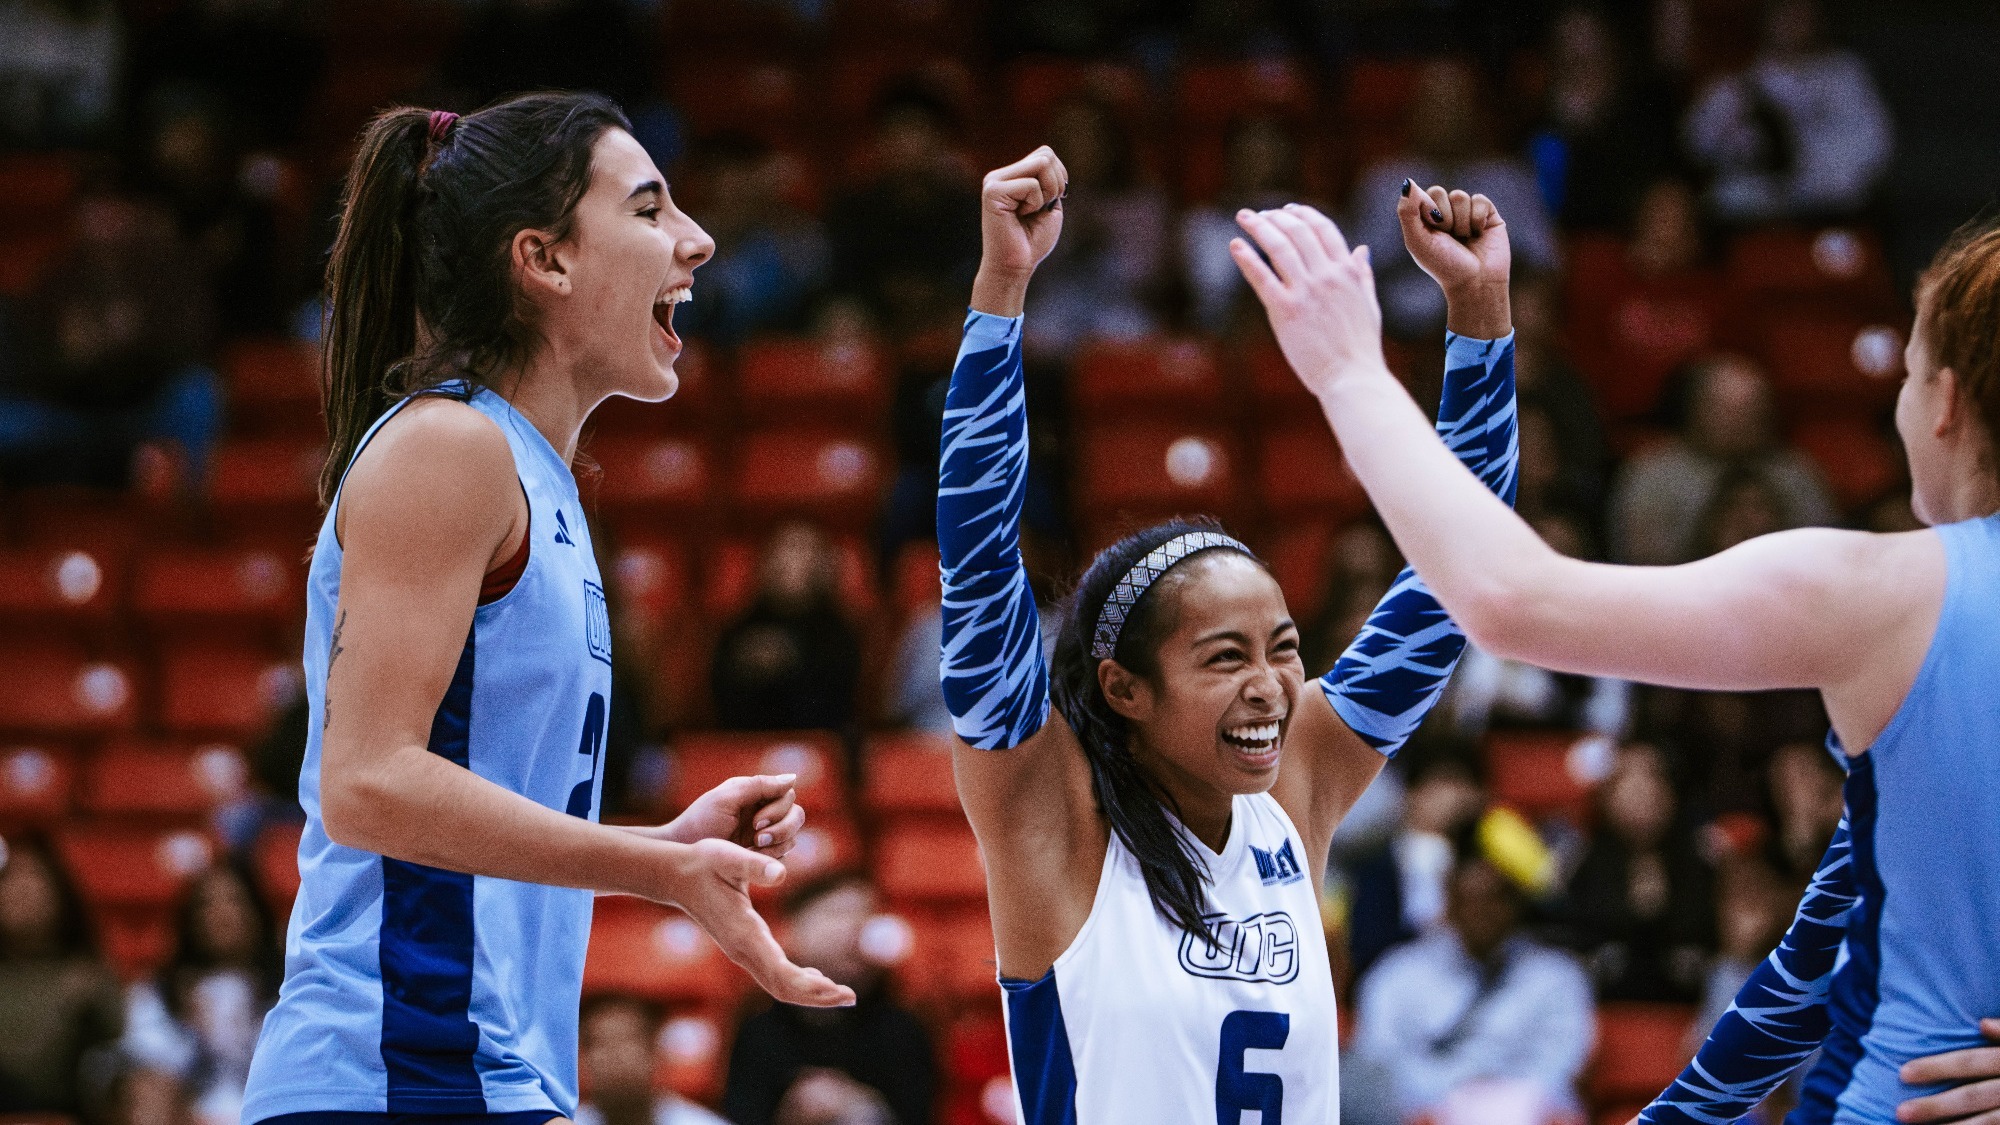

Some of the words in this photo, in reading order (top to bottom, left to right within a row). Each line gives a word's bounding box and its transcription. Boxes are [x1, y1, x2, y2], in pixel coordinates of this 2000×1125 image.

[566, 692, 605, 820] 2
[1178, 911, 1299, 985] UIC
[1216, 1010, 1290, 1125] 6
